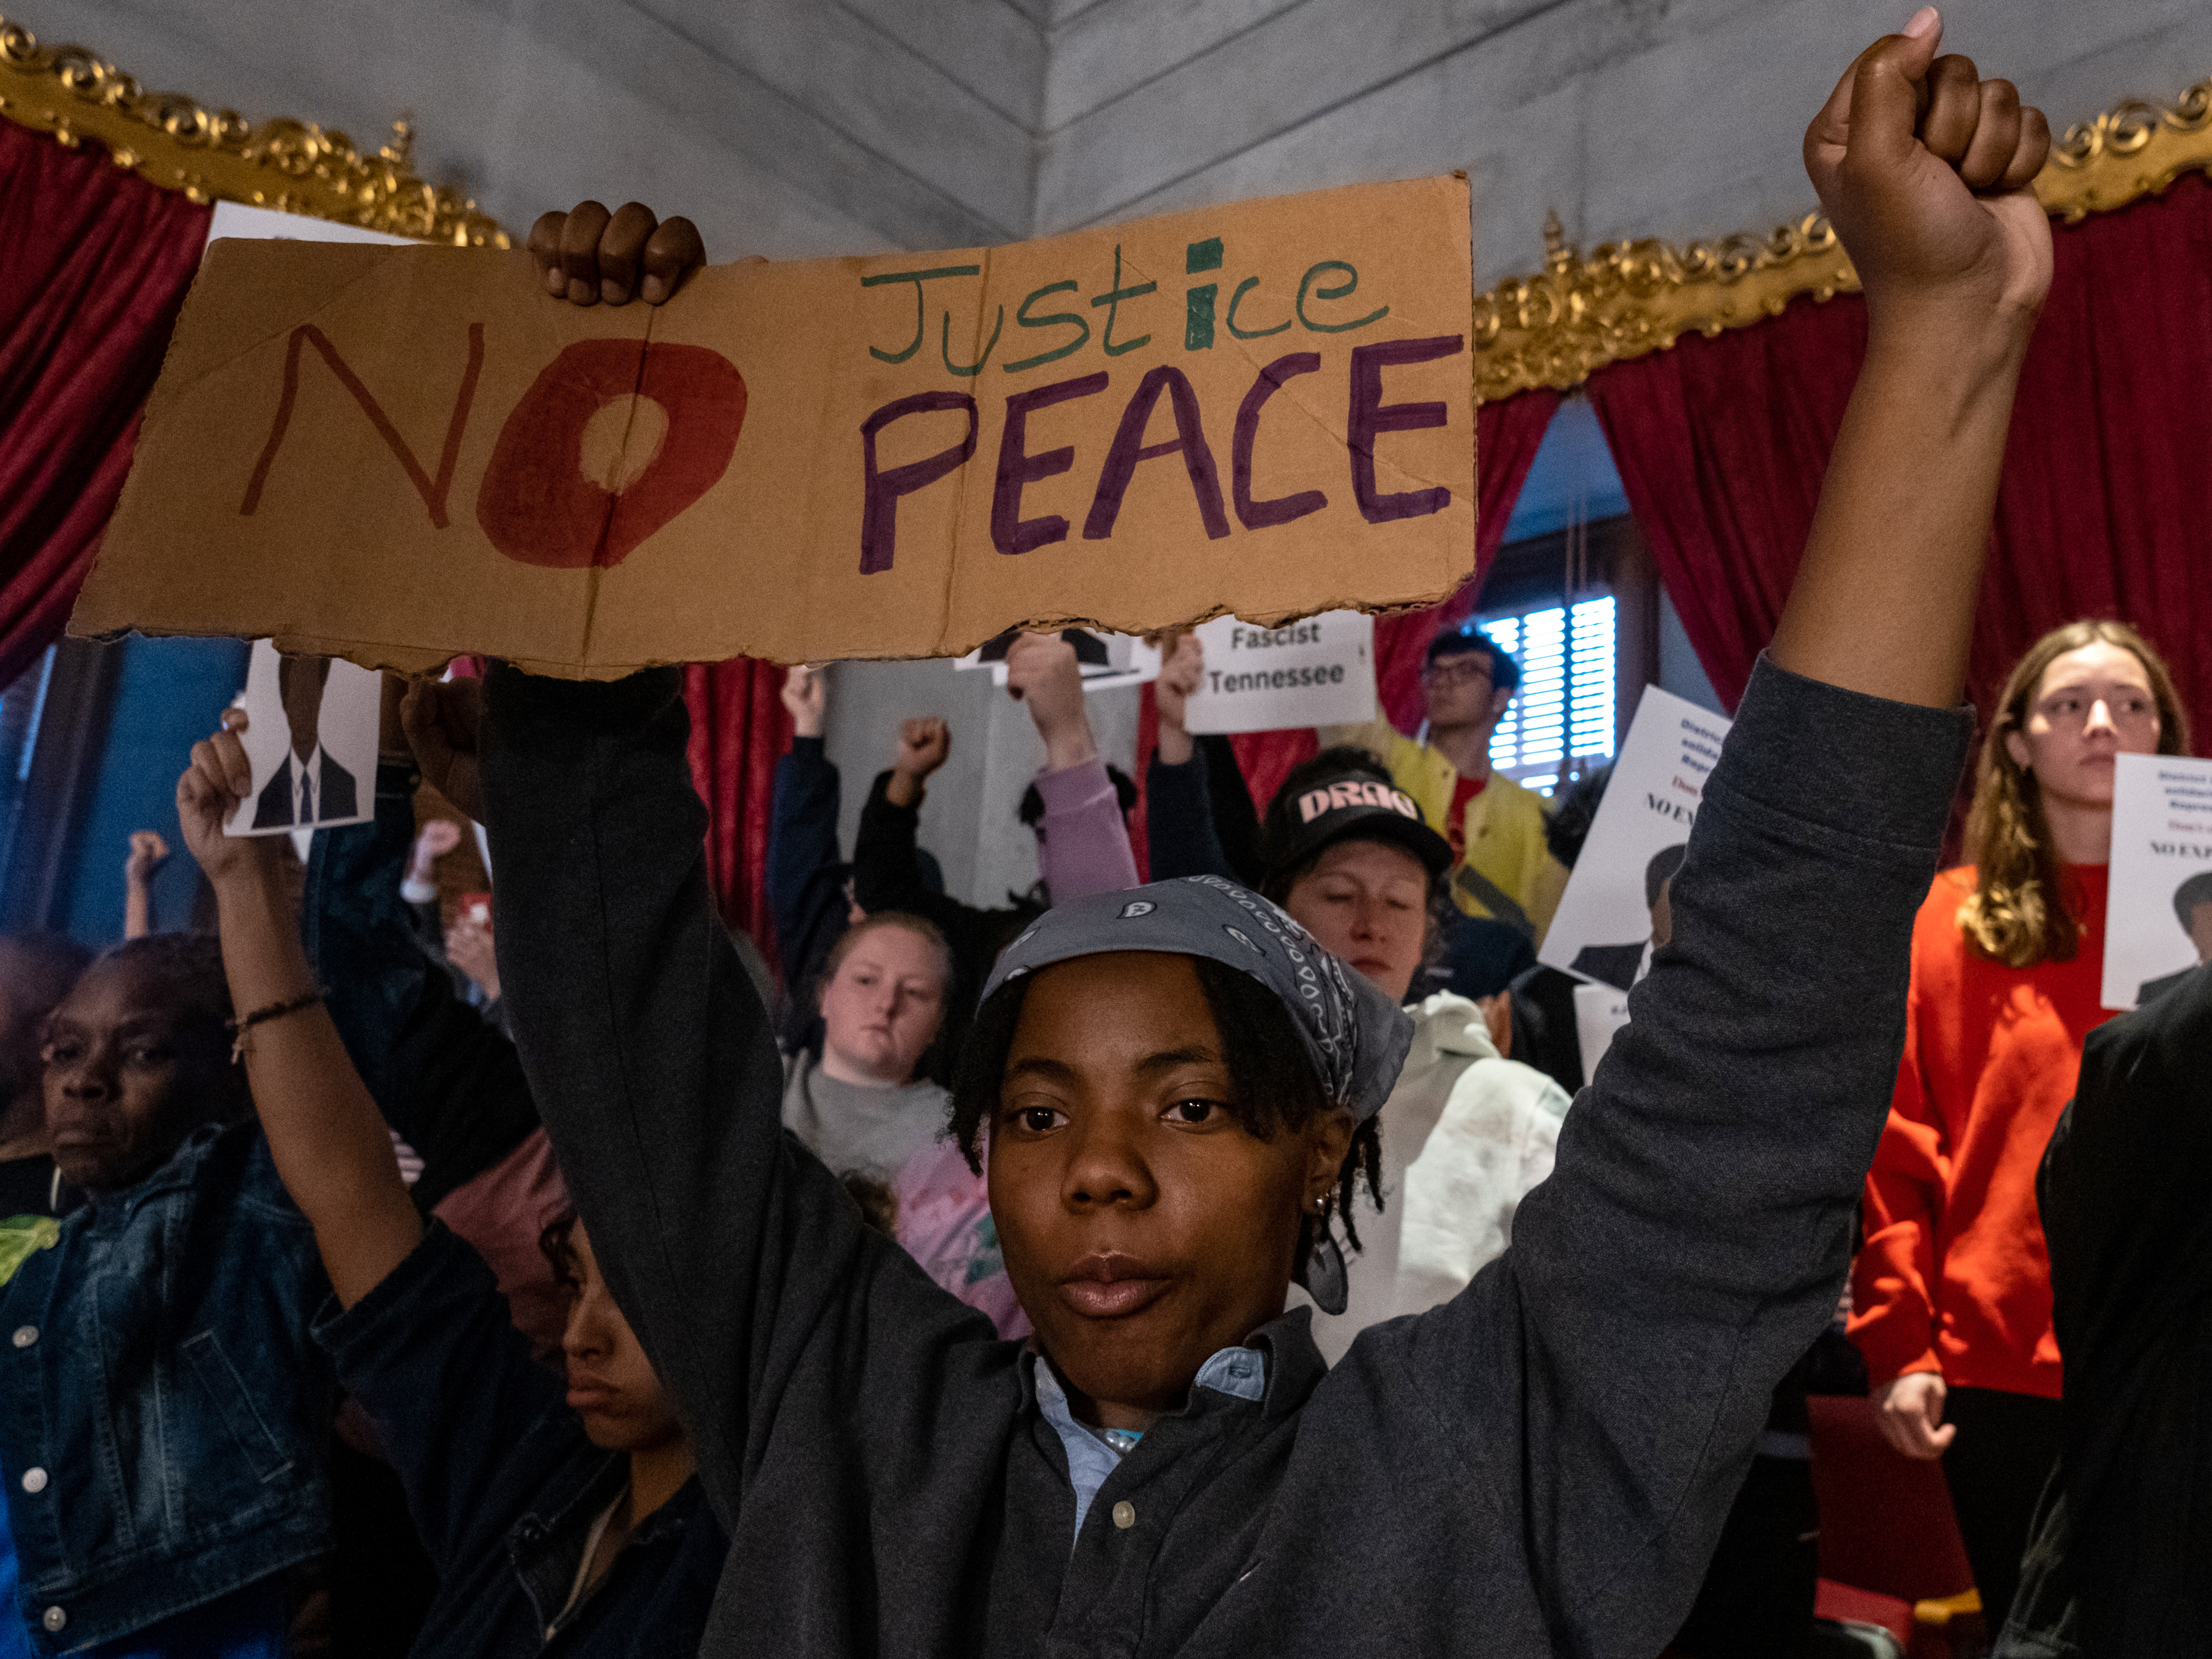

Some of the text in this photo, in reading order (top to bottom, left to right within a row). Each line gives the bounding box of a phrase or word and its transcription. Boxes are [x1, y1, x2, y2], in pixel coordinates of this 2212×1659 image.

[862, 237, 1388, 376] Justice
[240, 323, 747, 569] NO
[859, 334, 1463, 575] PEACE
[1232, 623, 1320, 649] Fascist
[1210, 664, 1344, 694] Tennessee
[1648, 793, 1671, 814] NO
